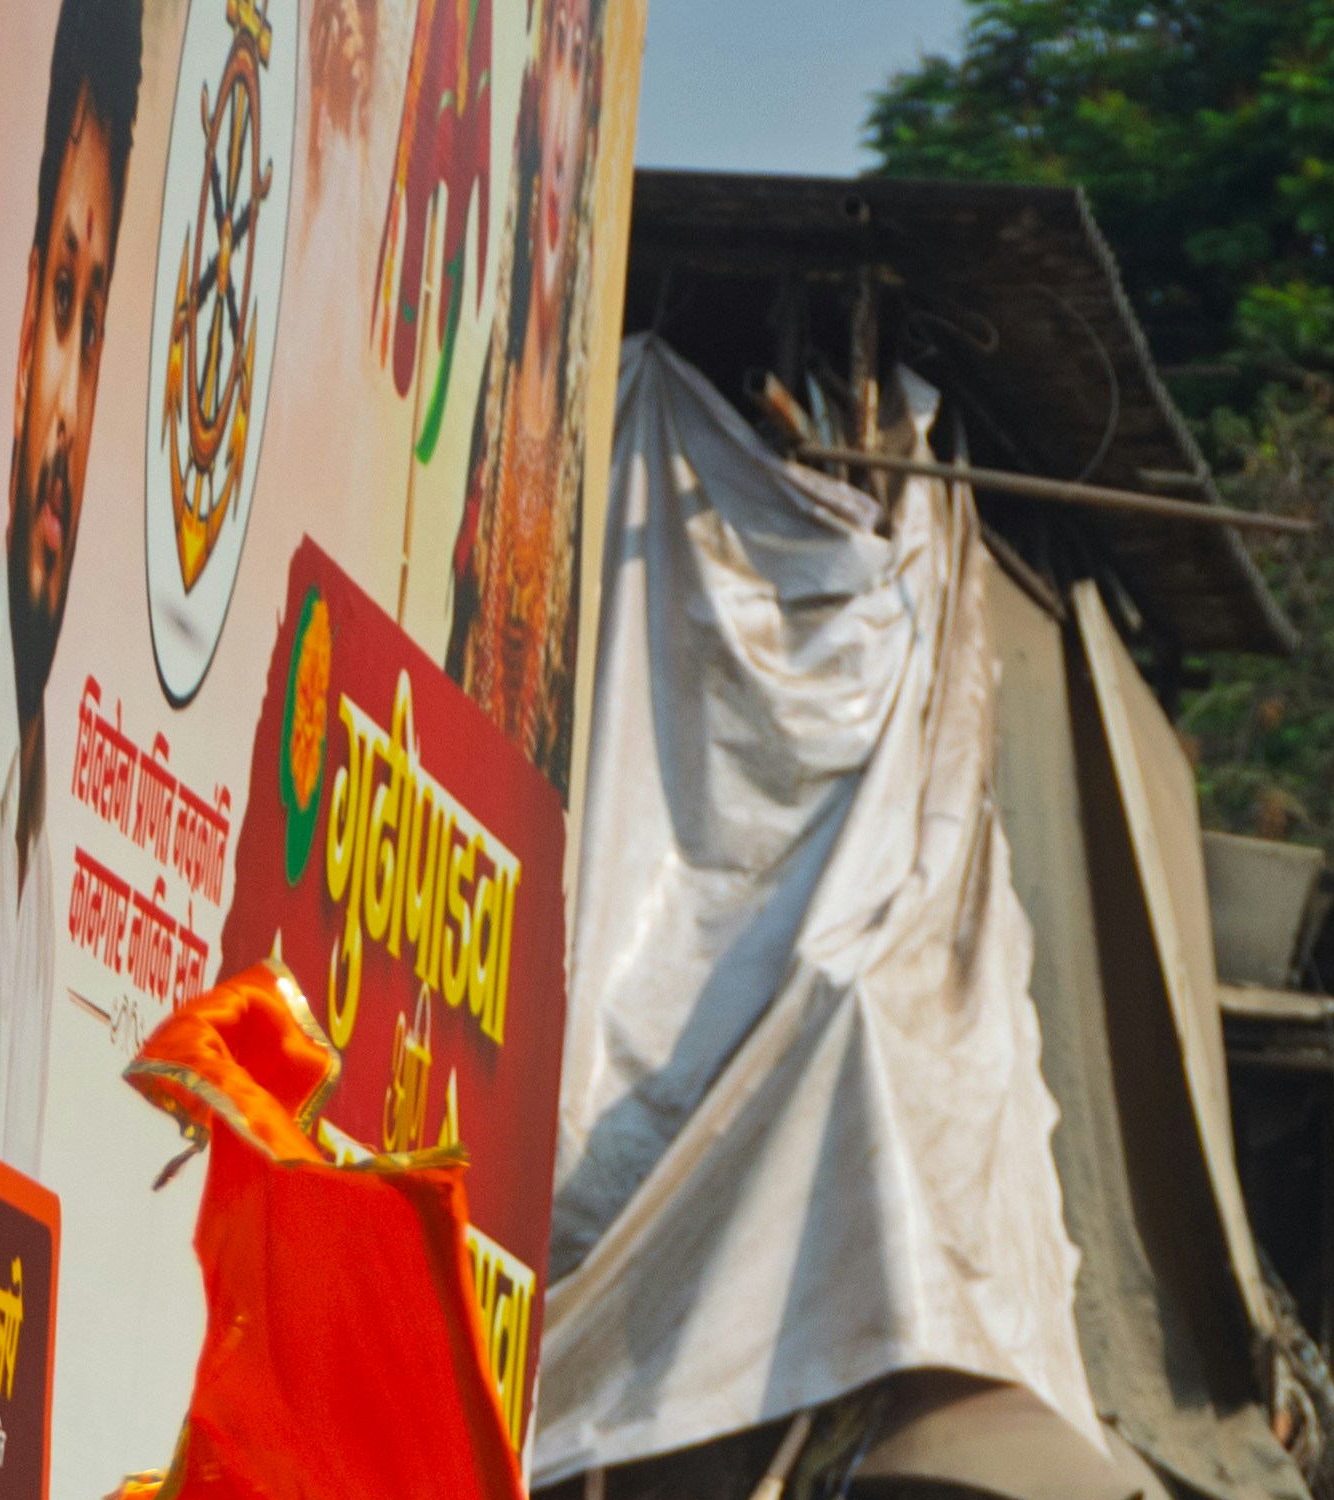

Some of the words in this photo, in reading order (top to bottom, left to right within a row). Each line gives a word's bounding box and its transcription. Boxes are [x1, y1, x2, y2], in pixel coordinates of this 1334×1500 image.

[71, 673, 139, 838] शिवसेना
[68, 844, 132, 976] कामगार
[127, 875, 179, 1005] नाविक
[173, 897, 209, 1017] सेना
[327, 668, 522, 1052] गुढीपाडवा
